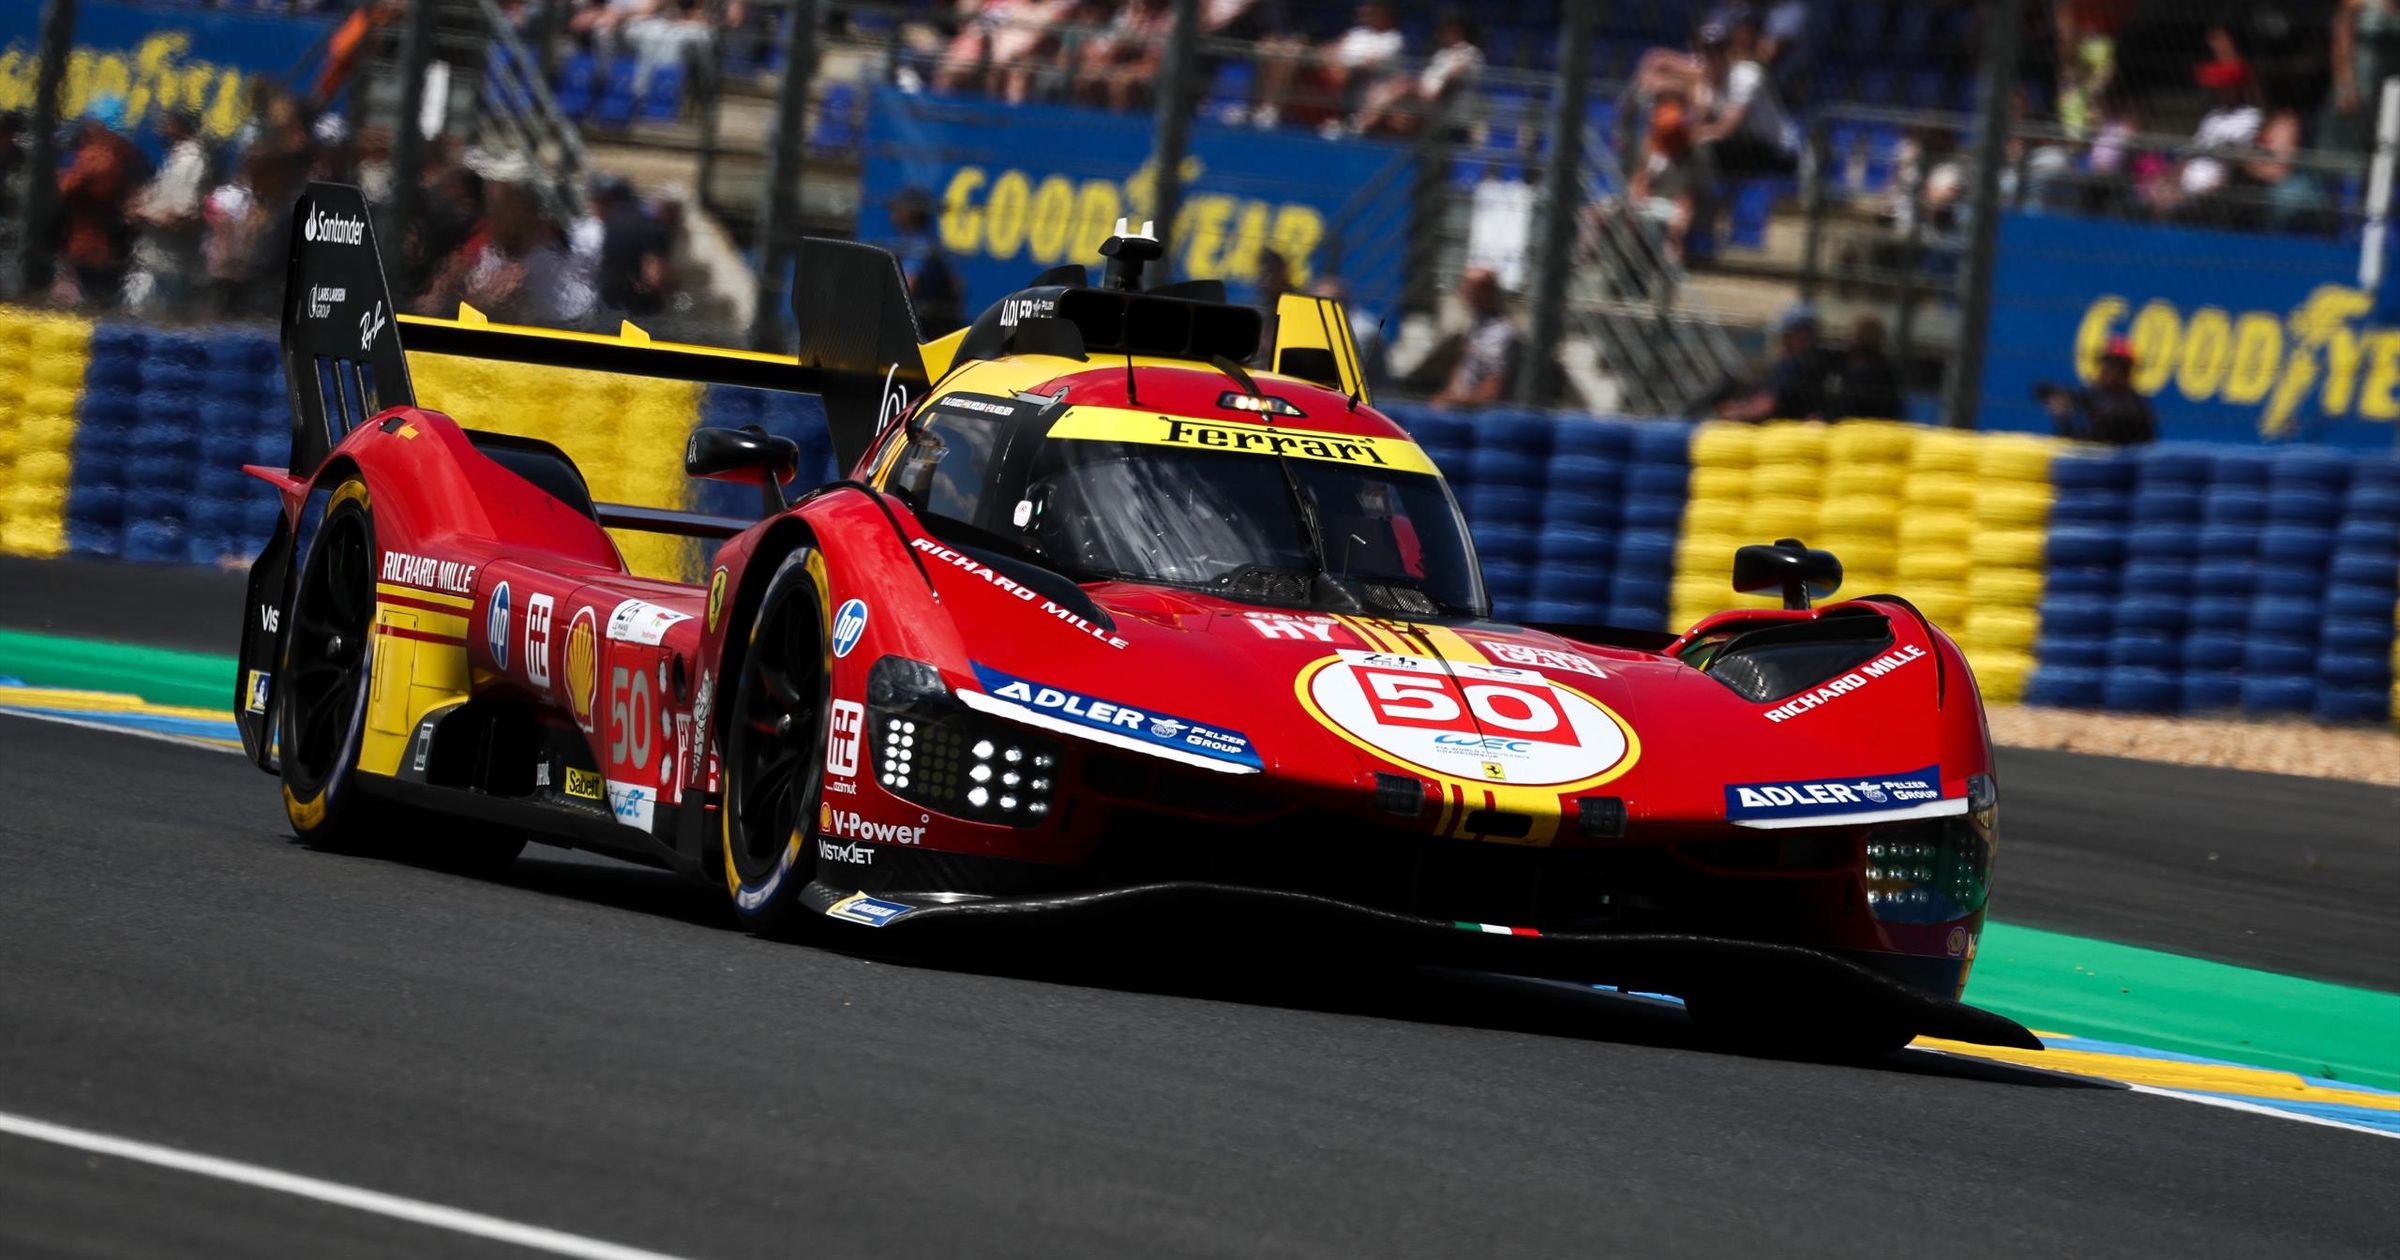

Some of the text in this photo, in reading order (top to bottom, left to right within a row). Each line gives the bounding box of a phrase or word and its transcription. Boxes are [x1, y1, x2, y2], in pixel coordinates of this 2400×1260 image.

[316, 210, 365, 246] Santander
[316, 304, 331, 318] GROUP
[1158, 416, 1388, 466] Ferrari
[383, 550, 477, 594] RICHARD MILLE
[910, 537, 1130, 651] RICHARD MILLE
[1365, 671, 1560, 733] 50
[1763, 644, 1927, 723] RICHARD MILLE
[612, 666, 651, 770] 50
[994, 680, 1247, 747] ADLER PELZER
[1186, 735, 1242, 754] GROUP
[1434, 734, 1532, 753] WEC
[569, 770, 600, 797] Sabelt
[1736, 781, 1929, 808] ADLER PELZER
[1893, 789, 1939, 801] GROUP
[832, 809, 926, 846] V-Power
